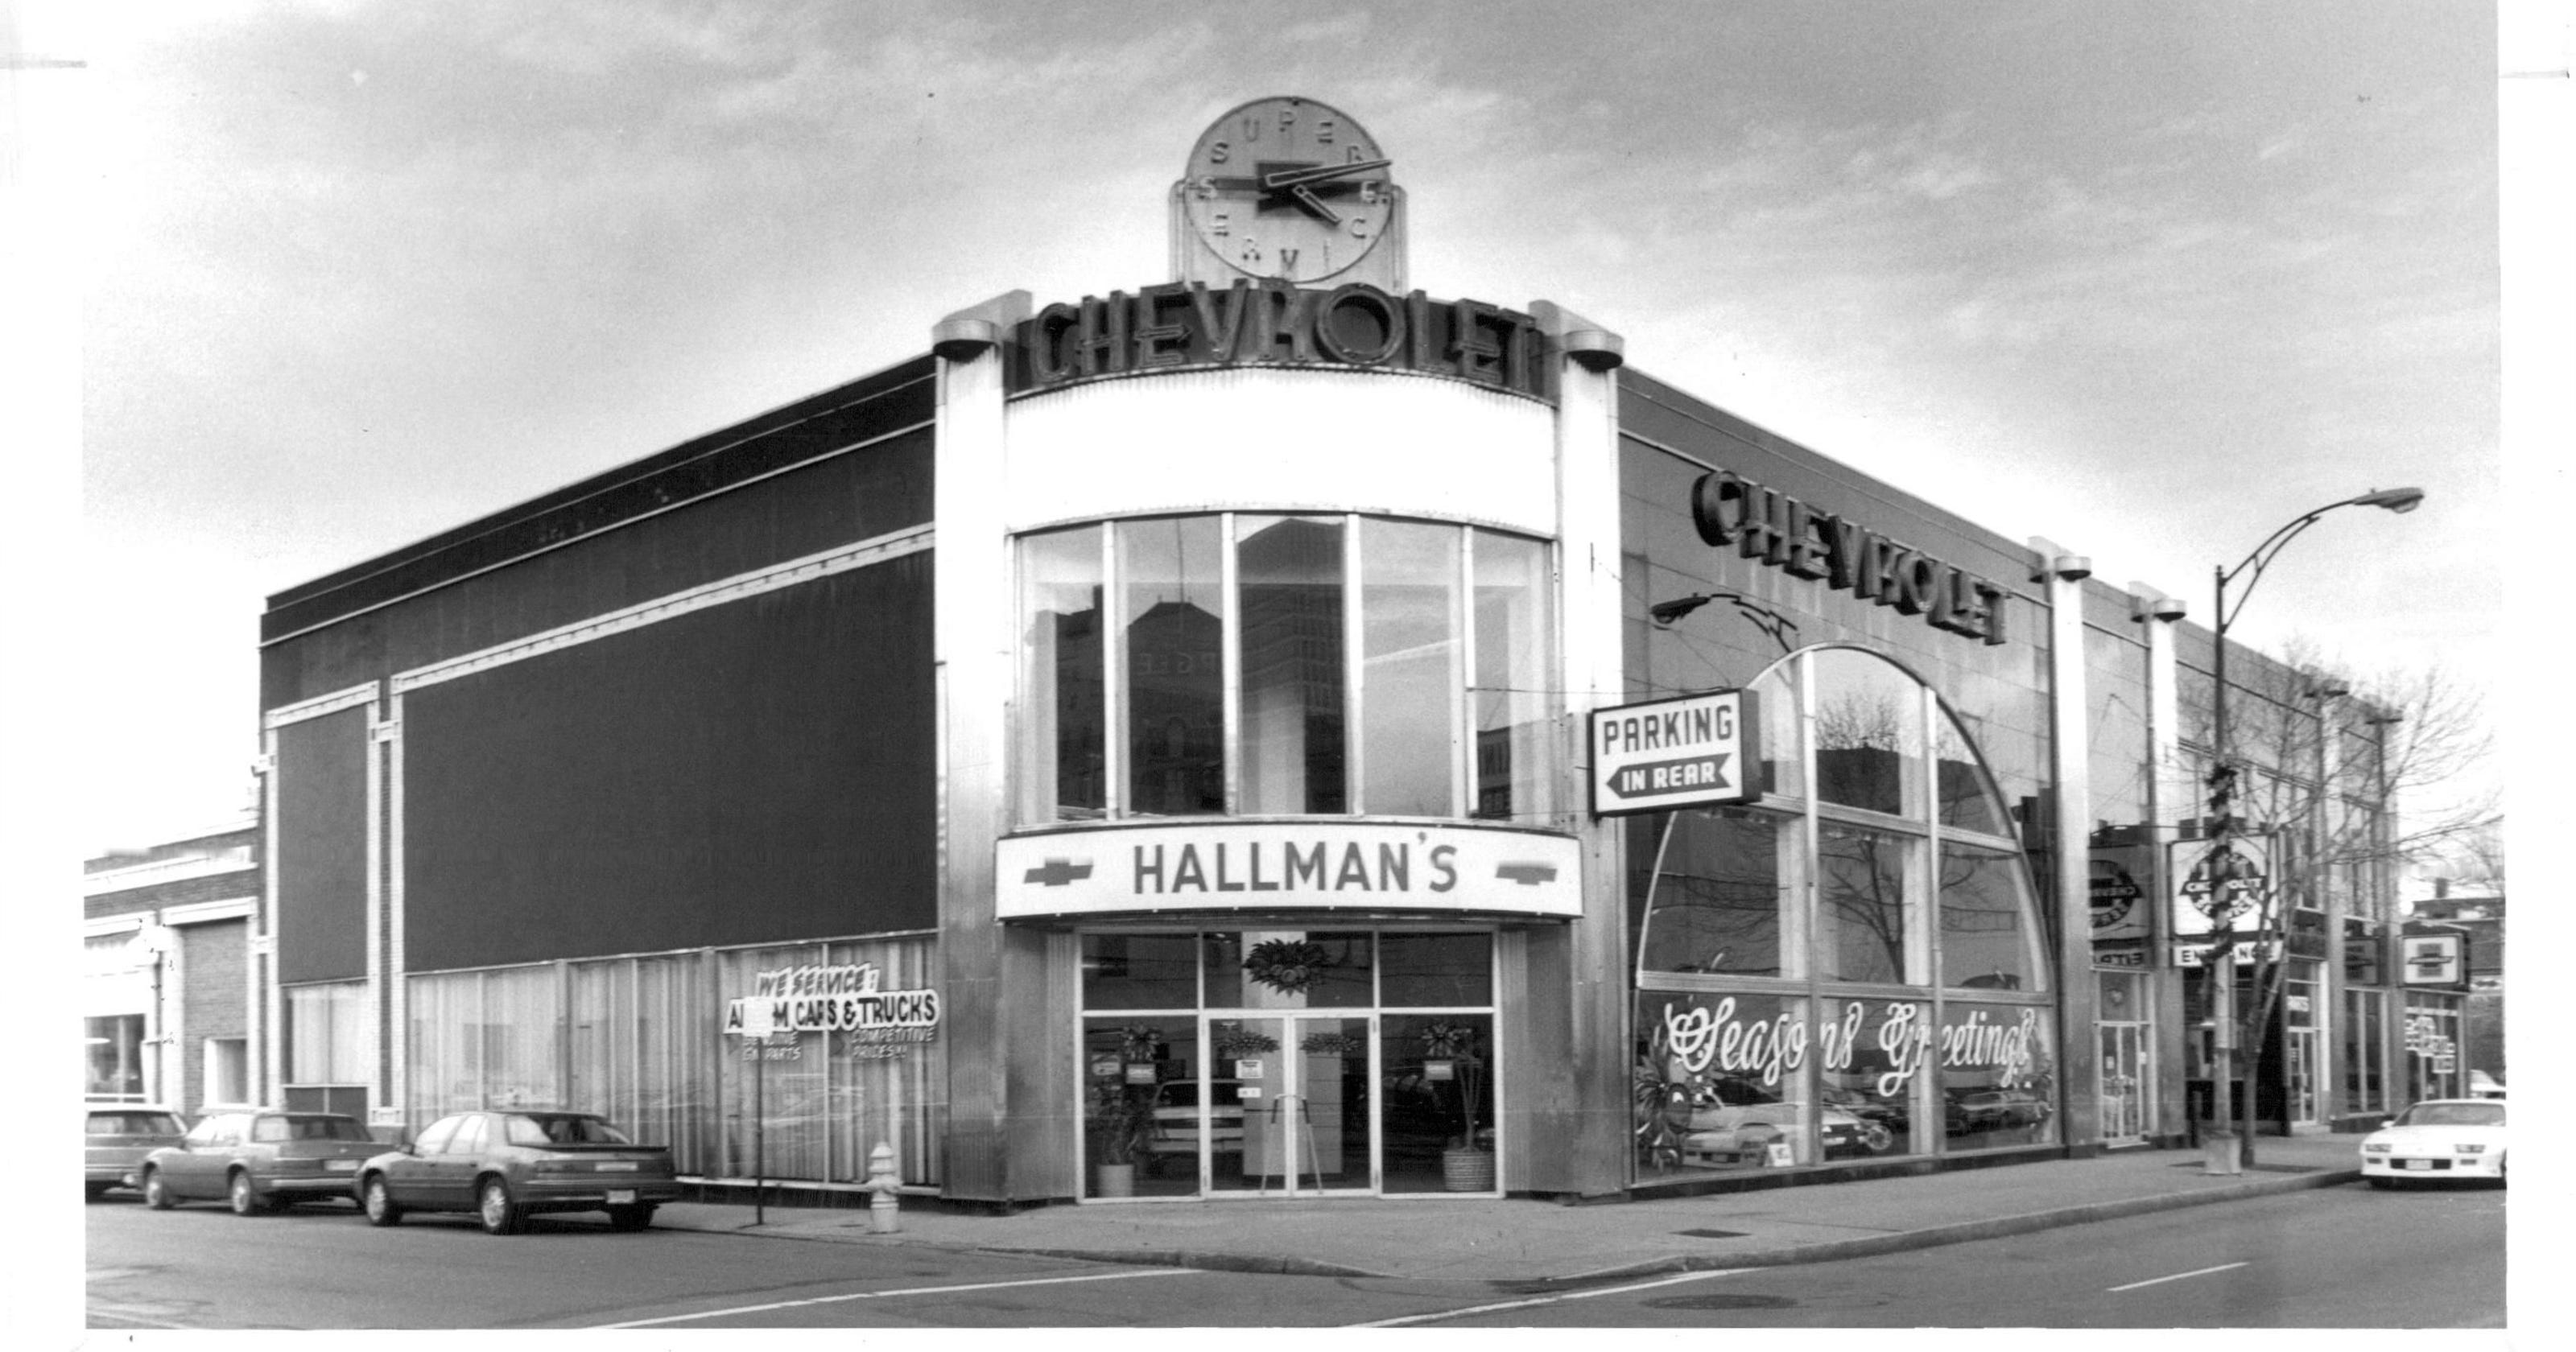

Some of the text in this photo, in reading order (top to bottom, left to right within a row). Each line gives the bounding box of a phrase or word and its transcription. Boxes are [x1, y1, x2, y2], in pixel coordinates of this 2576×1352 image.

[1210, 111, 1364, 163] SUPER
[1198, 176, 1381, 269] SERVICE
[1031, 277, 1538, 390] CHEVROLET
[1693, 471, 2009, 645] CHEVROLET
[1604, 705, 1732, 755] PARKING
[1622, 761, 1716, 792] IN REAR
[1133, 831, 1458, 893] HALLMAN'S
[758, 973, 789, 998] WE
[844, 1000, 856, 1026] &
[857, 994, 935, 1024] TRUCKS
[1877, 1003, 2036, 1097] Greetings
